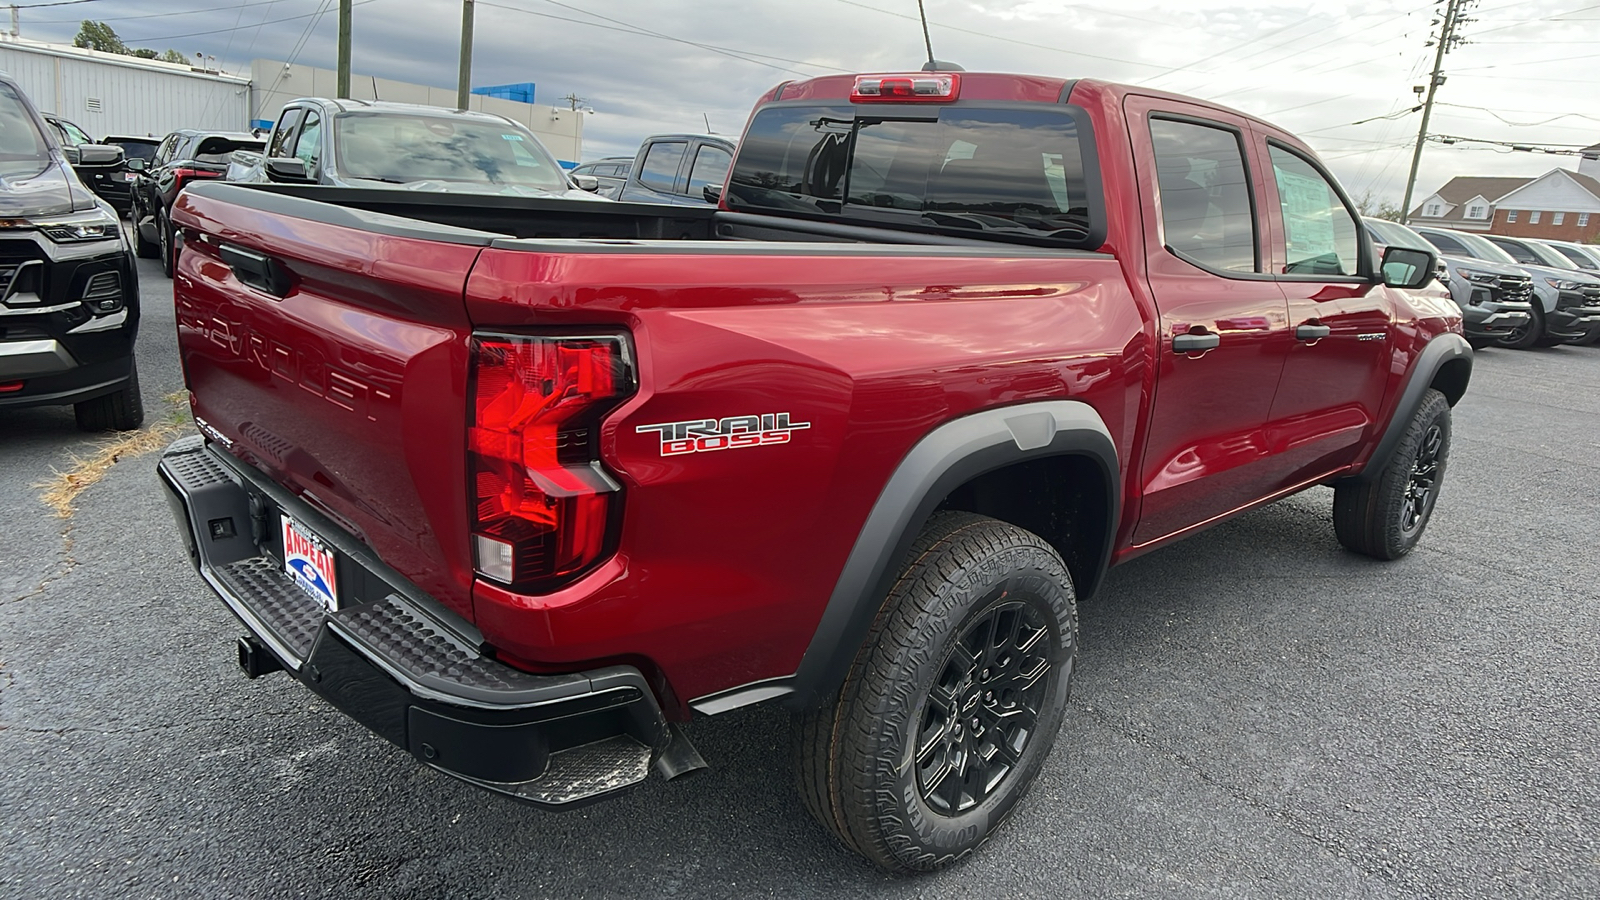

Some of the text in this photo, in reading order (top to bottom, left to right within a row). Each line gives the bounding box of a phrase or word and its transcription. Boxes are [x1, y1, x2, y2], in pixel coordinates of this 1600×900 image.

[636, 412, 811, 442] TRAIL
[660, 429, 790, 457] BOSS
[286, 523, 335, 595] ANDEAN
[904, 783, 978, 849] GOODYEAR
